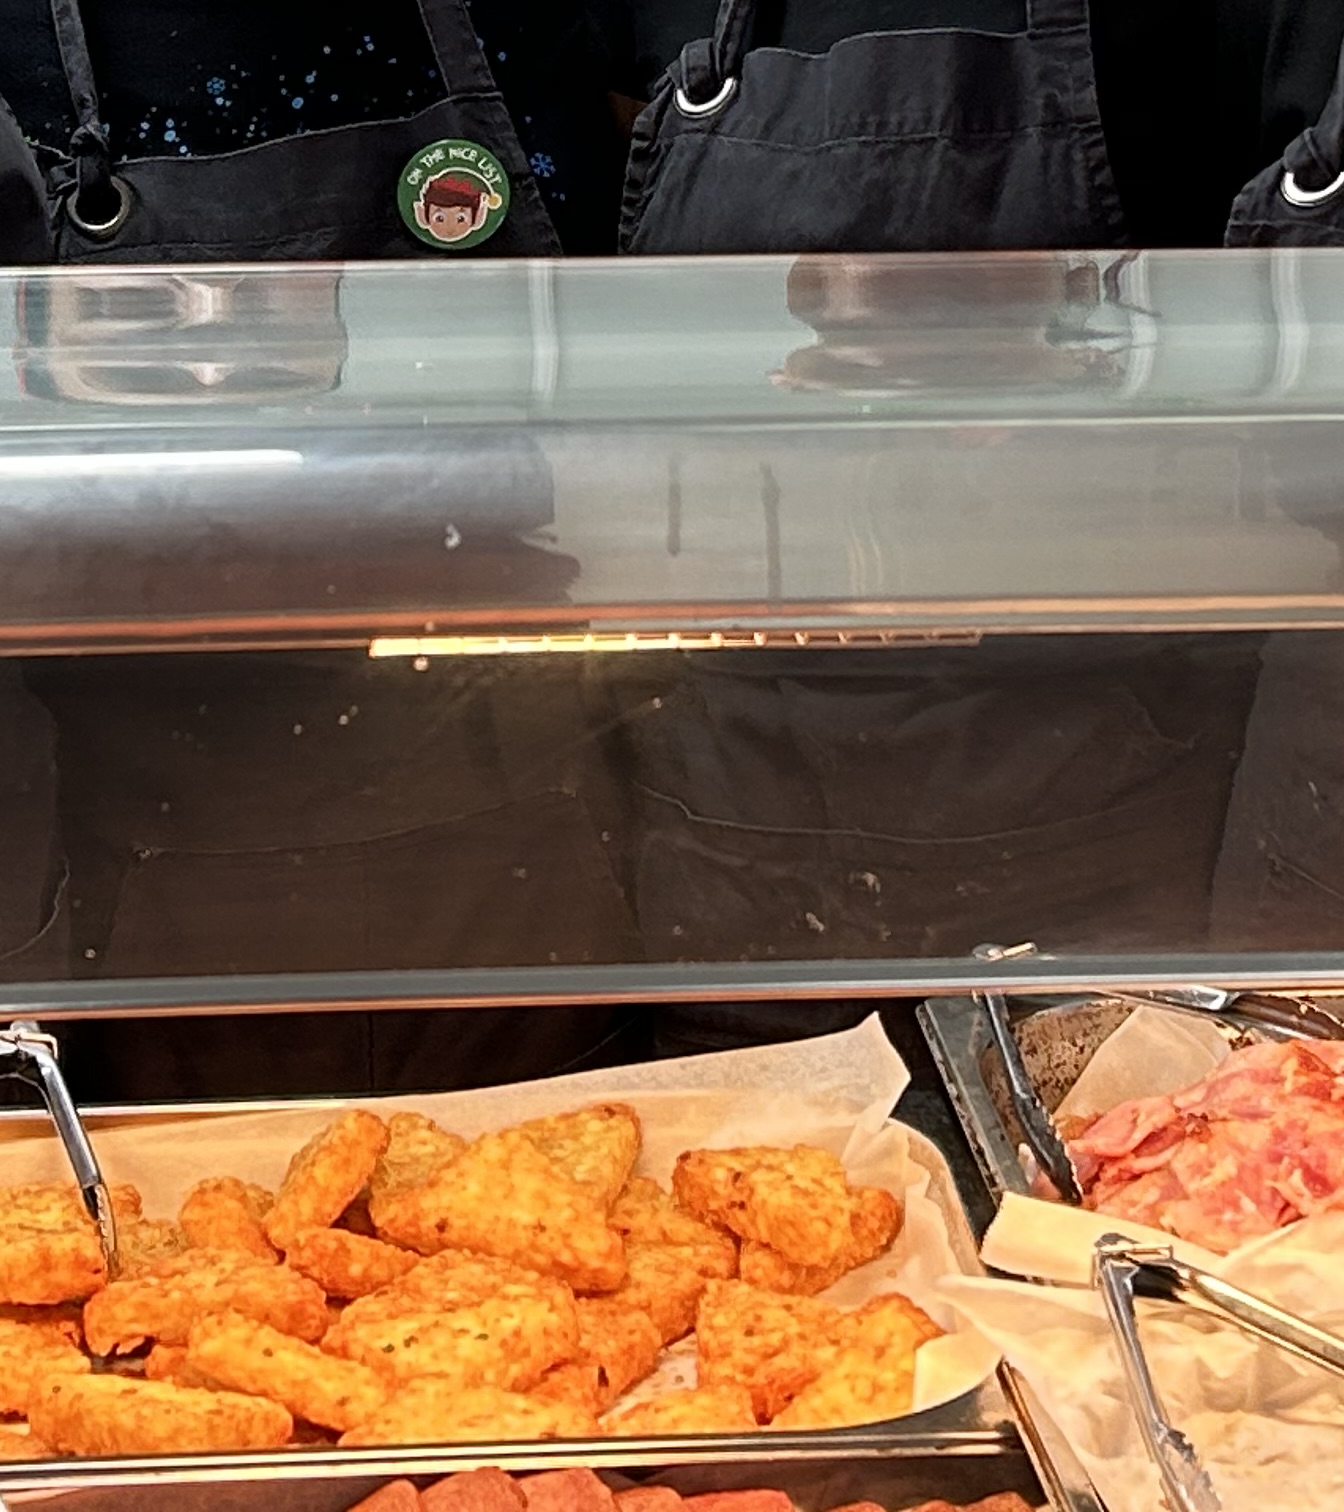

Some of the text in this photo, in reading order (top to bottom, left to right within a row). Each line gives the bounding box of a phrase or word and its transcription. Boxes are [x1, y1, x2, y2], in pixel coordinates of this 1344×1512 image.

[407, 147, 503, 186] ON THE NICE LIST
